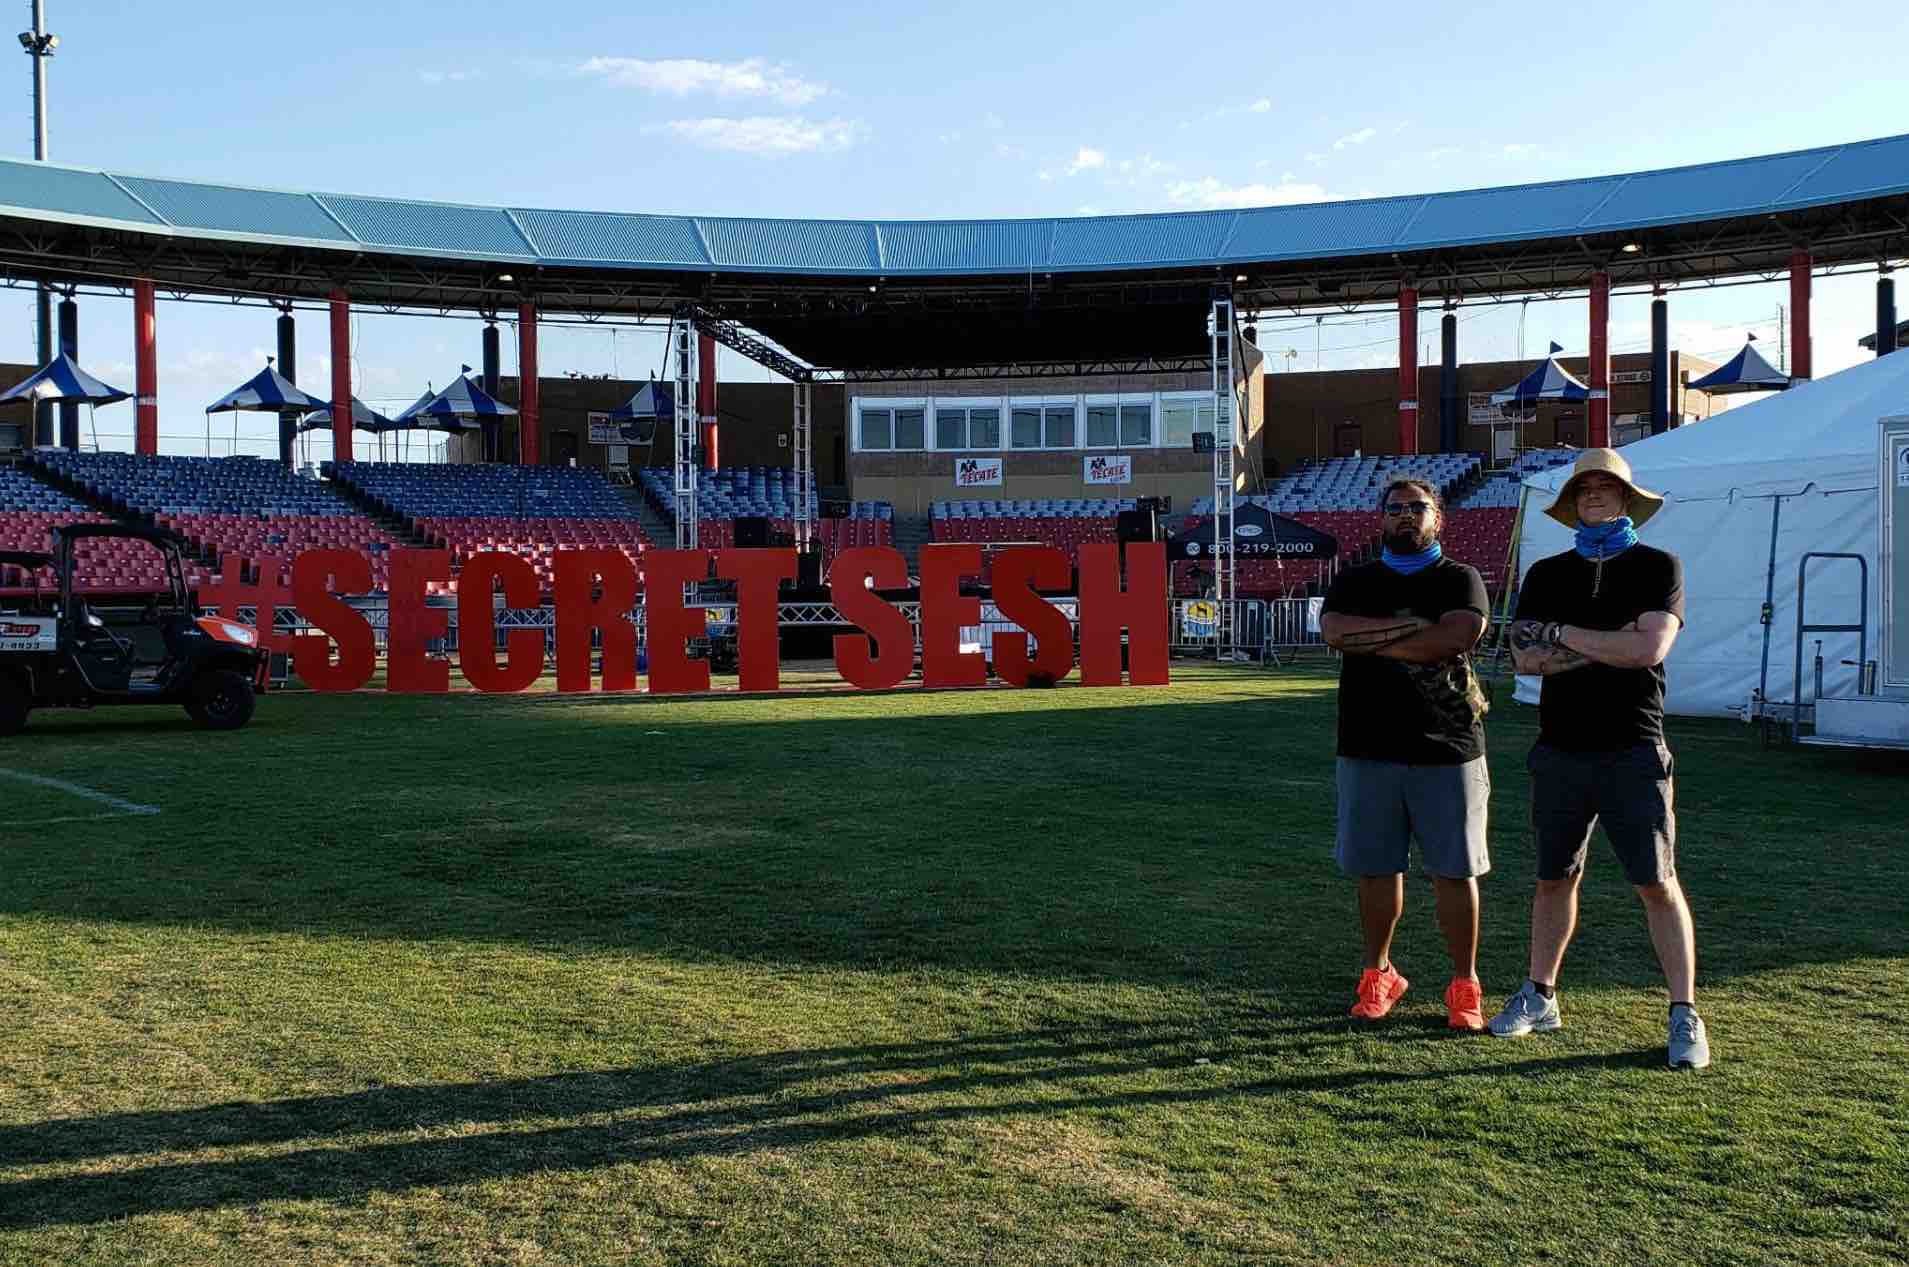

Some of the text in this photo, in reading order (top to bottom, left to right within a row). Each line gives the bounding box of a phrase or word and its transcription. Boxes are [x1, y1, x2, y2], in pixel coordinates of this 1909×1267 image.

[963, 465, 999, 482] TECATE
[1091, 464, 1126, 481] TECATE
[1208, 542, 1314, 554] 800-219-2000
